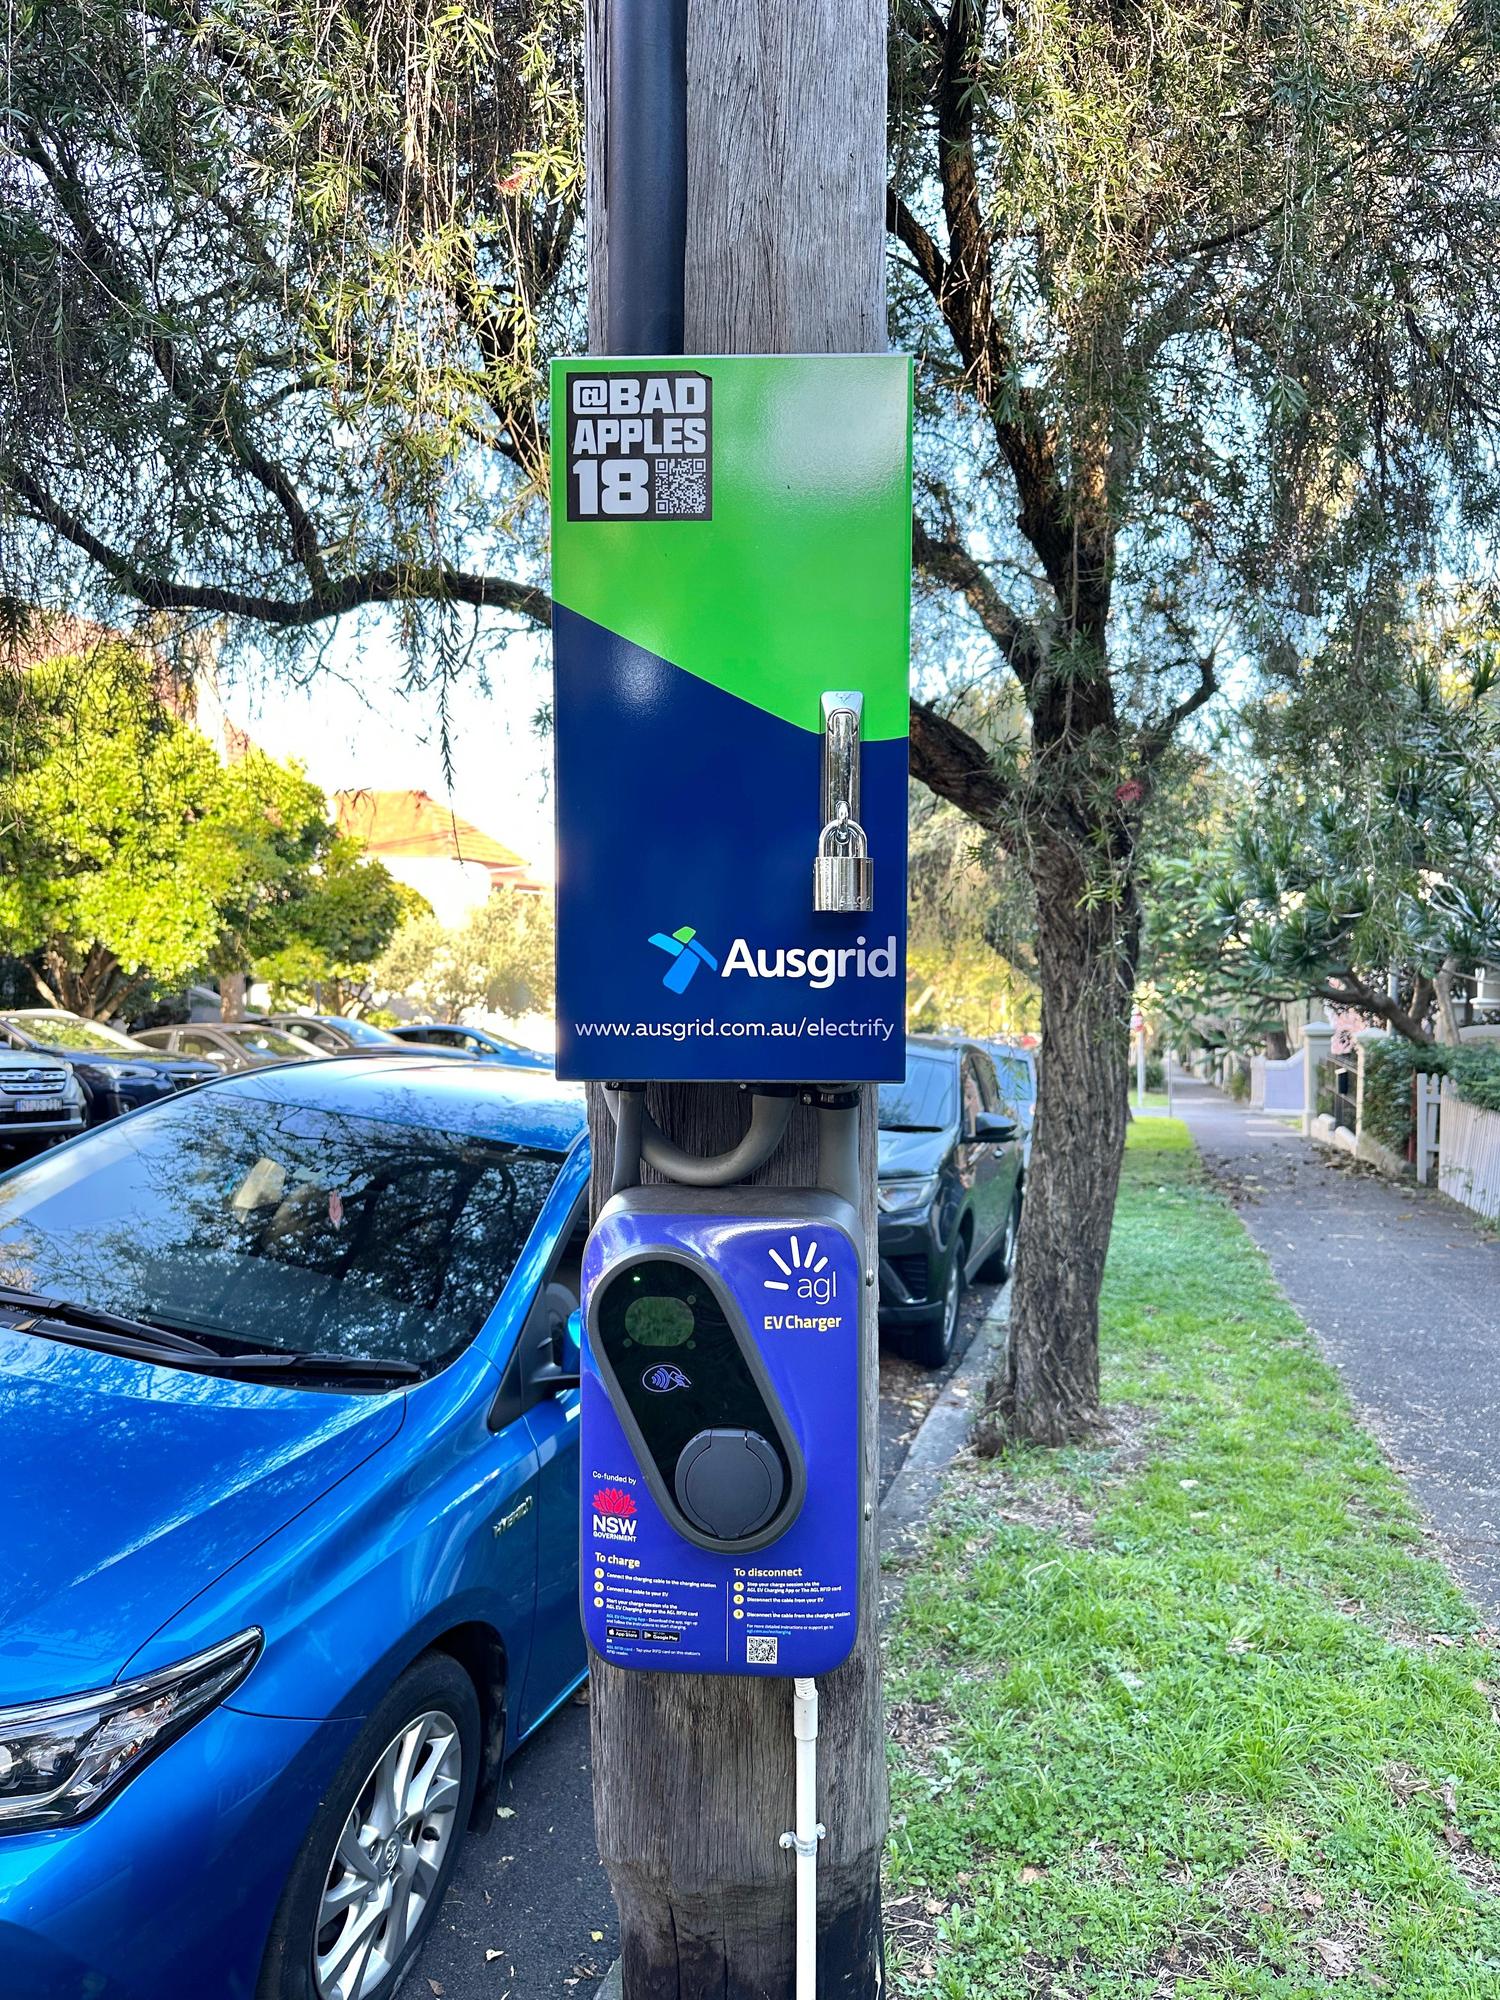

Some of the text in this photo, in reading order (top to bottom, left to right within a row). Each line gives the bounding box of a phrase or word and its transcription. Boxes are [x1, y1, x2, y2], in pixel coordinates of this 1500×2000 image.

[572, 378, 706, 415] @BAD
[572, 417, 706, 455] APPLES
[572, 459, 649, 515] 18
[721, 935, 896, 989] Ausgrid
[575, 1017, 894, 1041] www.ausgrid.com.au/electrify
[797, 1271, 837, 1305] agl
[764, 1315, 842, 1332] EV Charger
[593, 1471, 637, 1485] Co-funded by
[593, 1514, 637, 1536] NSW
[593, 1531, 637, 1542] GOVERNMENT
[595, 1552, 640, 1569] To charge
[607, 1572, 624, 1580] Connect
[633, 1576, 652, 1584] charging
[680, 1580, 700, 1588] charging
[734, 1568, 802, 1577] To disconnect
[607, 1585, 624, 1593] Connect
[622, 1605, 642, 1614] Charging
[629, 1601, 644, 1609] charge
